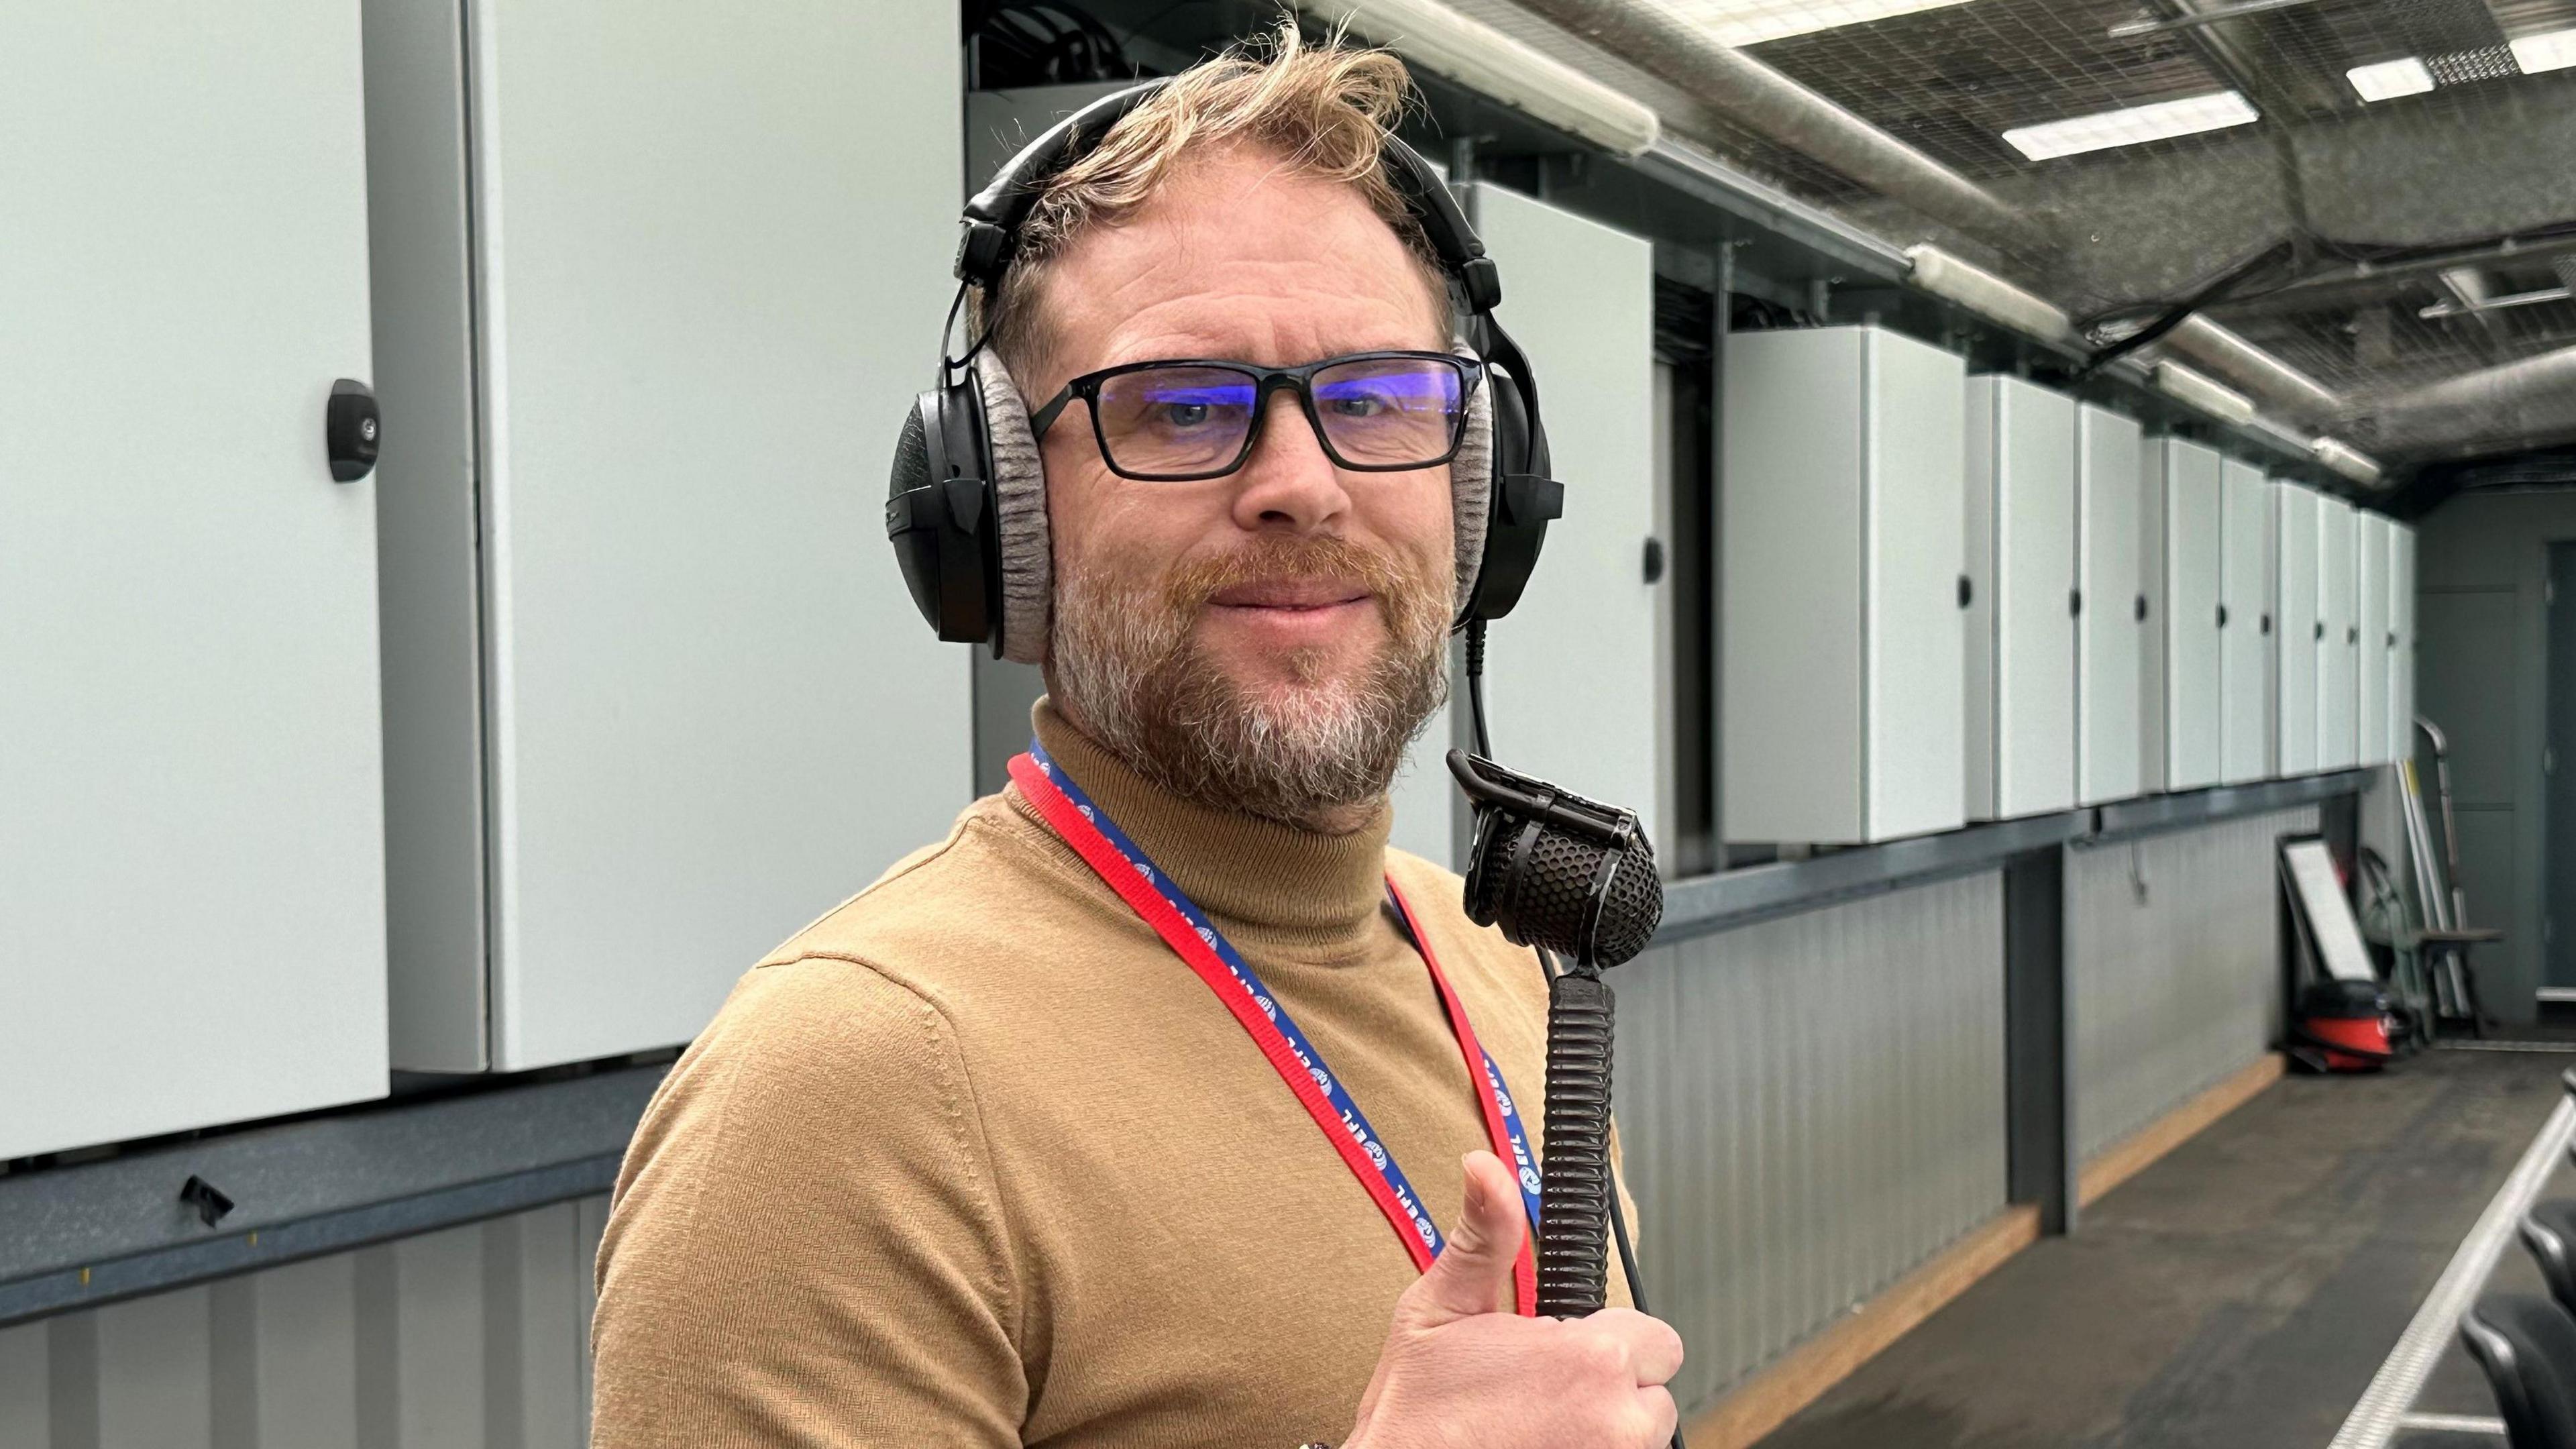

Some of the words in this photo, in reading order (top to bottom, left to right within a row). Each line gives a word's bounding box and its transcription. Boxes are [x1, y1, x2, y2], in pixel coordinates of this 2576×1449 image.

[1342, 1109, 1368, 1144] EFL
[1509, 1134, 1529, 1165] EFL
[1395, 1184, 1419, 1220] EFL
